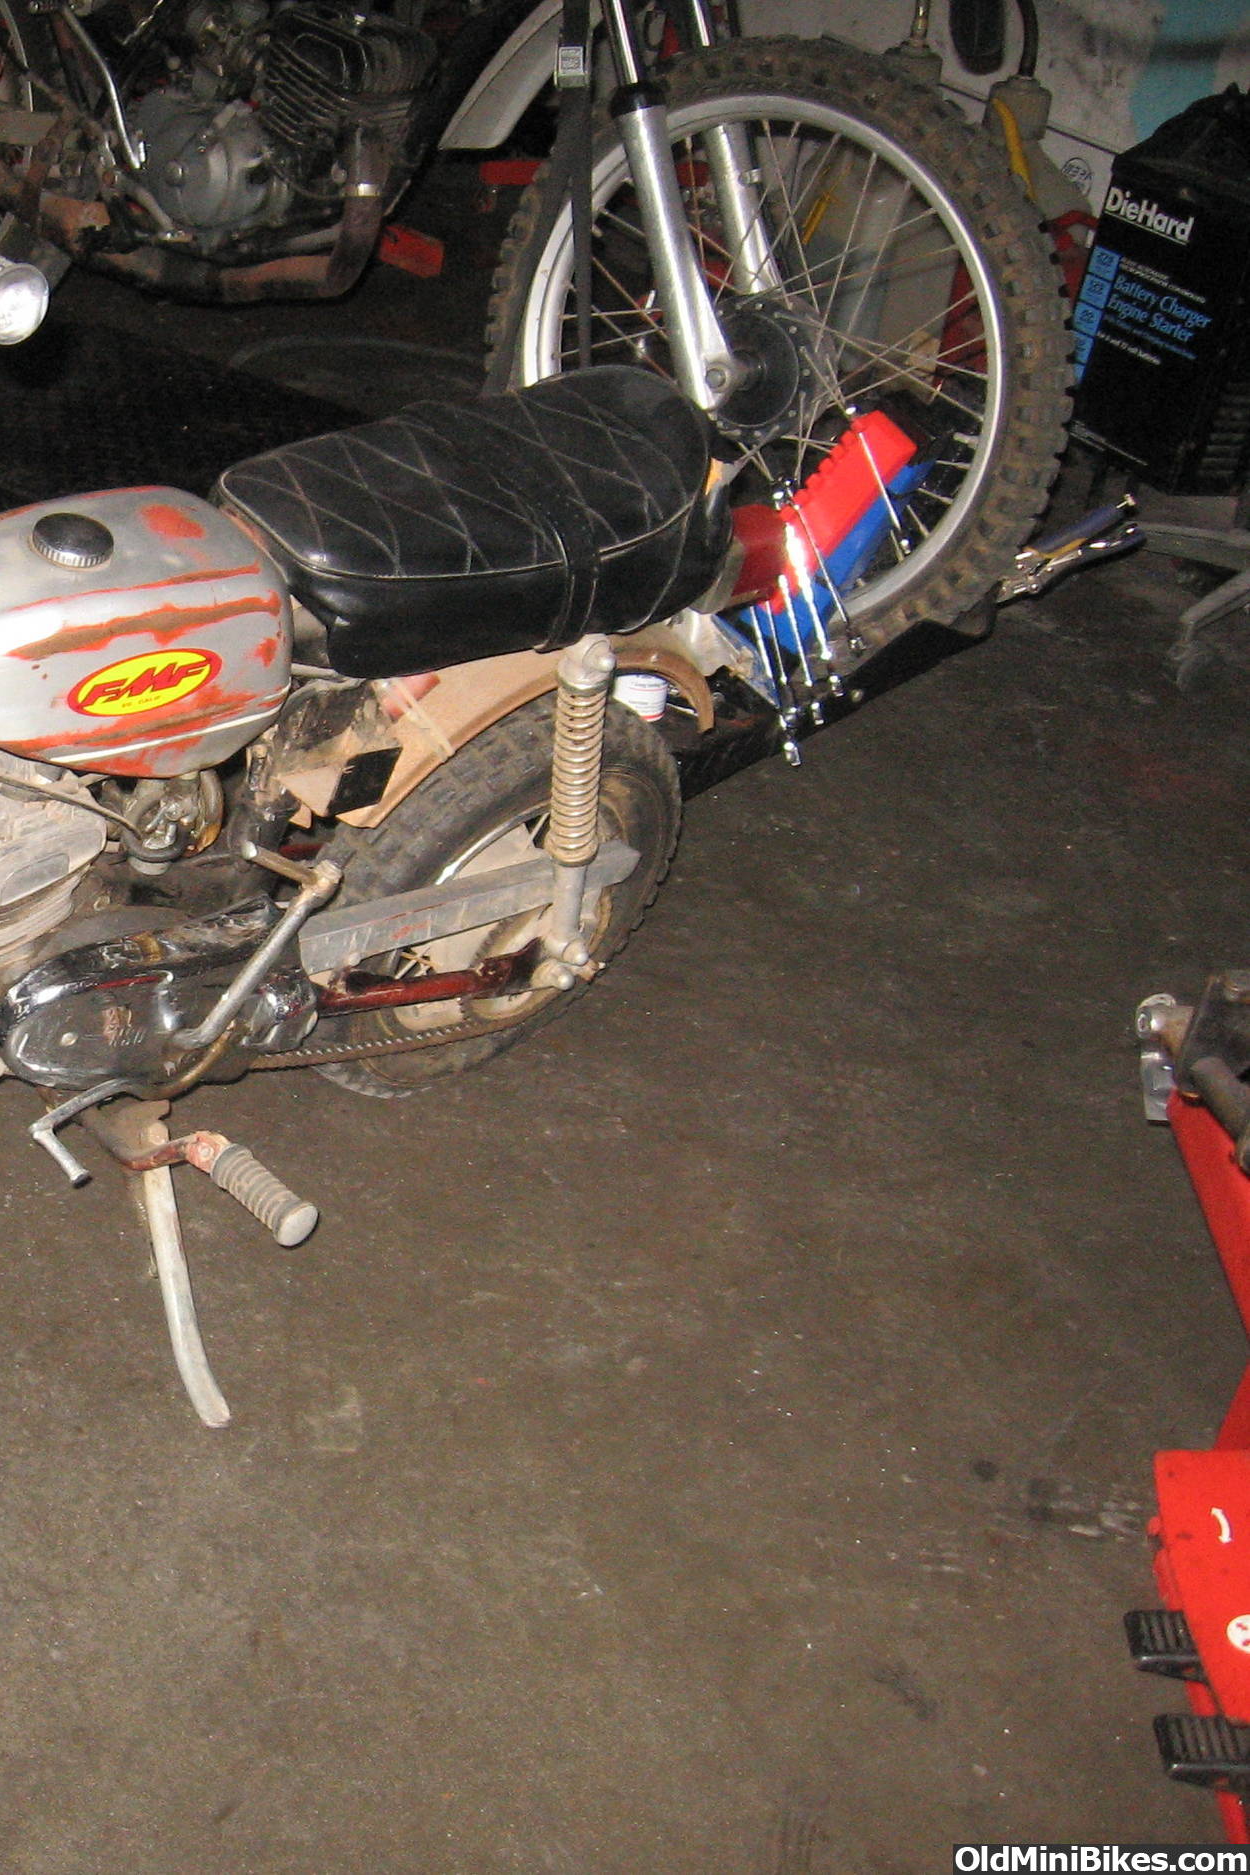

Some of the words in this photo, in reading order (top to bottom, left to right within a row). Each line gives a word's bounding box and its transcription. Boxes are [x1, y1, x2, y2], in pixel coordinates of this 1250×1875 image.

[1105, 187, 1195, 242] DieHard
[1107, 294, 1149, 320] Engine
[1150, 312, 1195, 342] Starter
[1113, 274, 1160, 307] Battery
[1159, 296, 1213, 328] Charger
[79, 659, 210, 707] FMF
